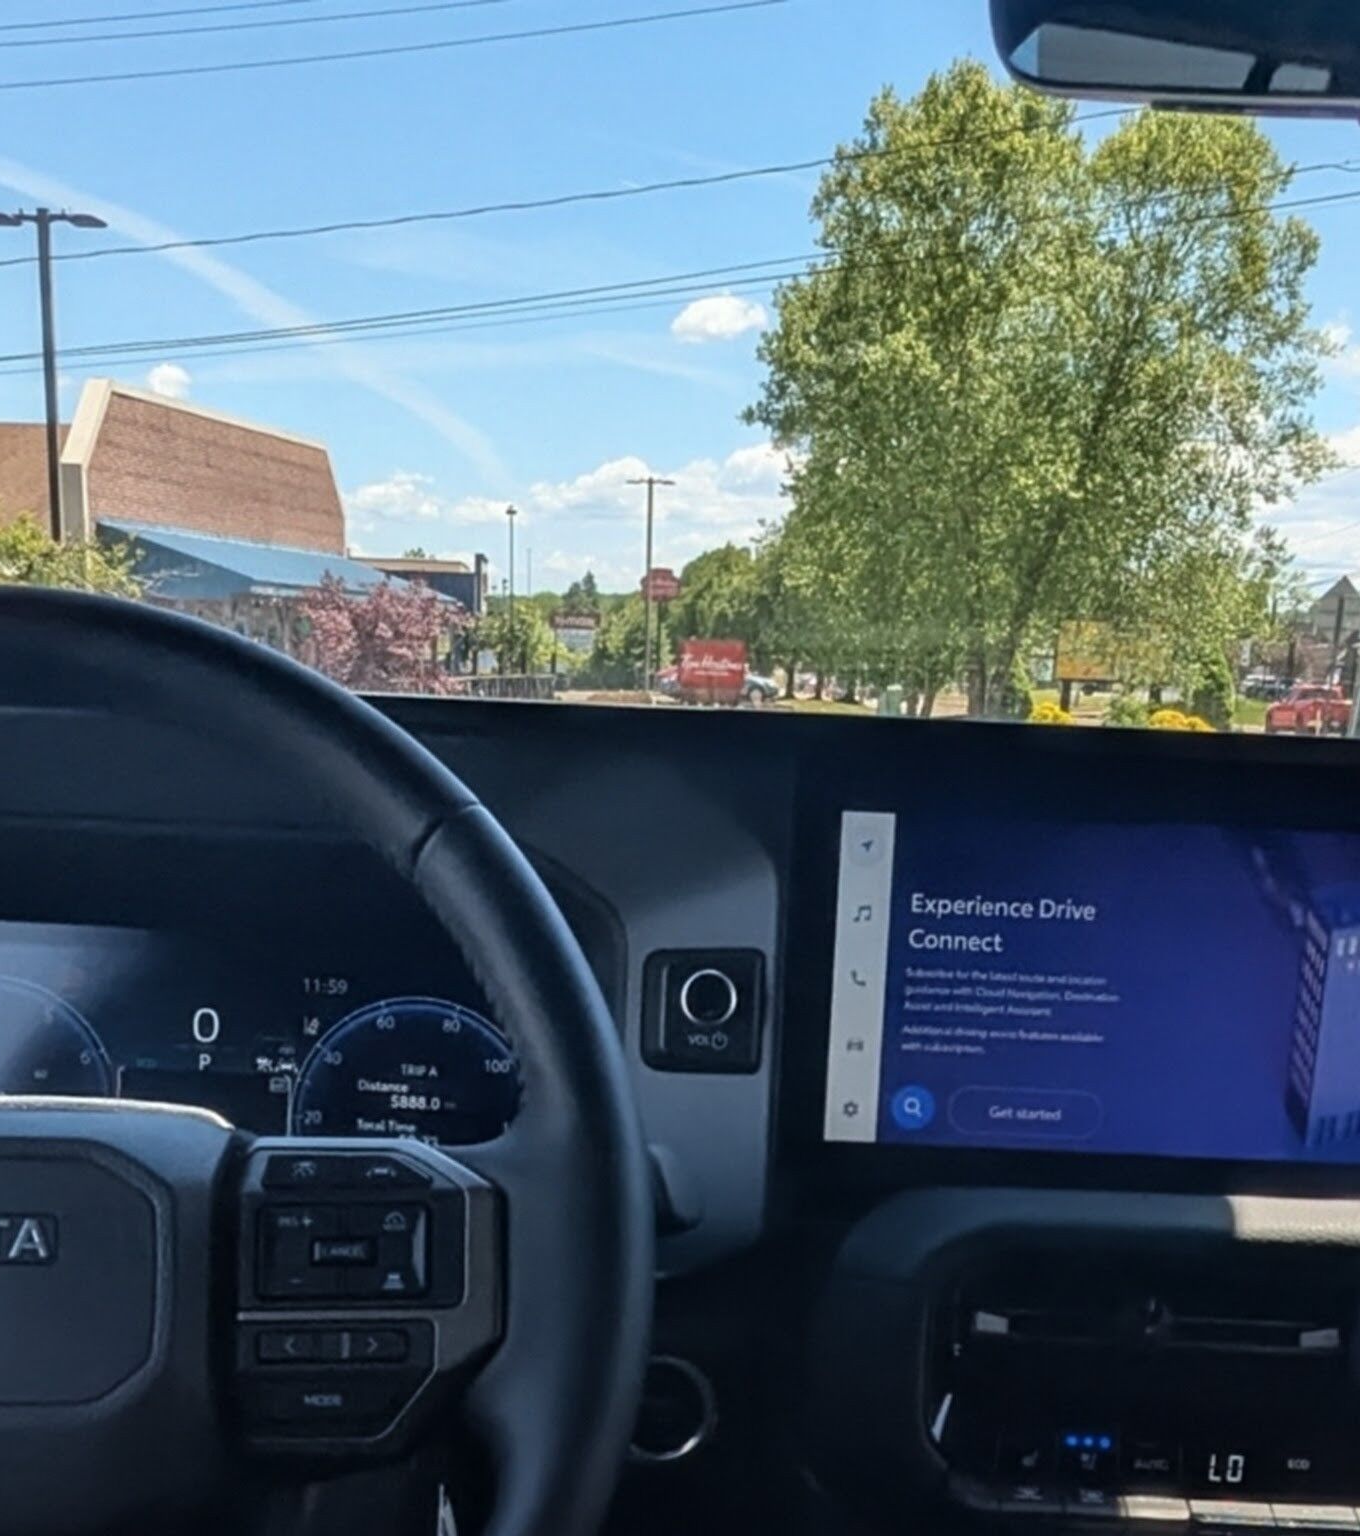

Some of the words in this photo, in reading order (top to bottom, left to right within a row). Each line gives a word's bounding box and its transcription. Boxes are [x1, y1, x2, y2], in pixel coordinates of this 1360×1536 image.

[910, 892, 1034, 919] Experience
[1038, 898, 1097, 921] Drive
[907, 928, 1004, 953] Connect
[303, 977, 348, 995] 11:59
[192, 1007, 220, 1043] 0
[376, 1015, 396, 1031] 60
[442, 1018, 462, 1034] 80
[687, 1034, 710, 1047] VOL
[198, 1053, 212, 1071] P
[400, 1063, 426, 1077] TRIP
[428, 1064, 439, 1078] A
[483, 1058, 510, 1075] 100
[357, 1078, 409, 1094] Distance
[390, 1094, 441, 1111] 5888.0
[304, 1109, 322, 1126] 20
[989, 1104, 1012, 1119] Get
[1015, 1107, 1062, 1121] started
[356, 1118, 385, 1132] Total
[387, 1119, 417, 1134] Time
[1207, 1453, 1246, 1484] LO
